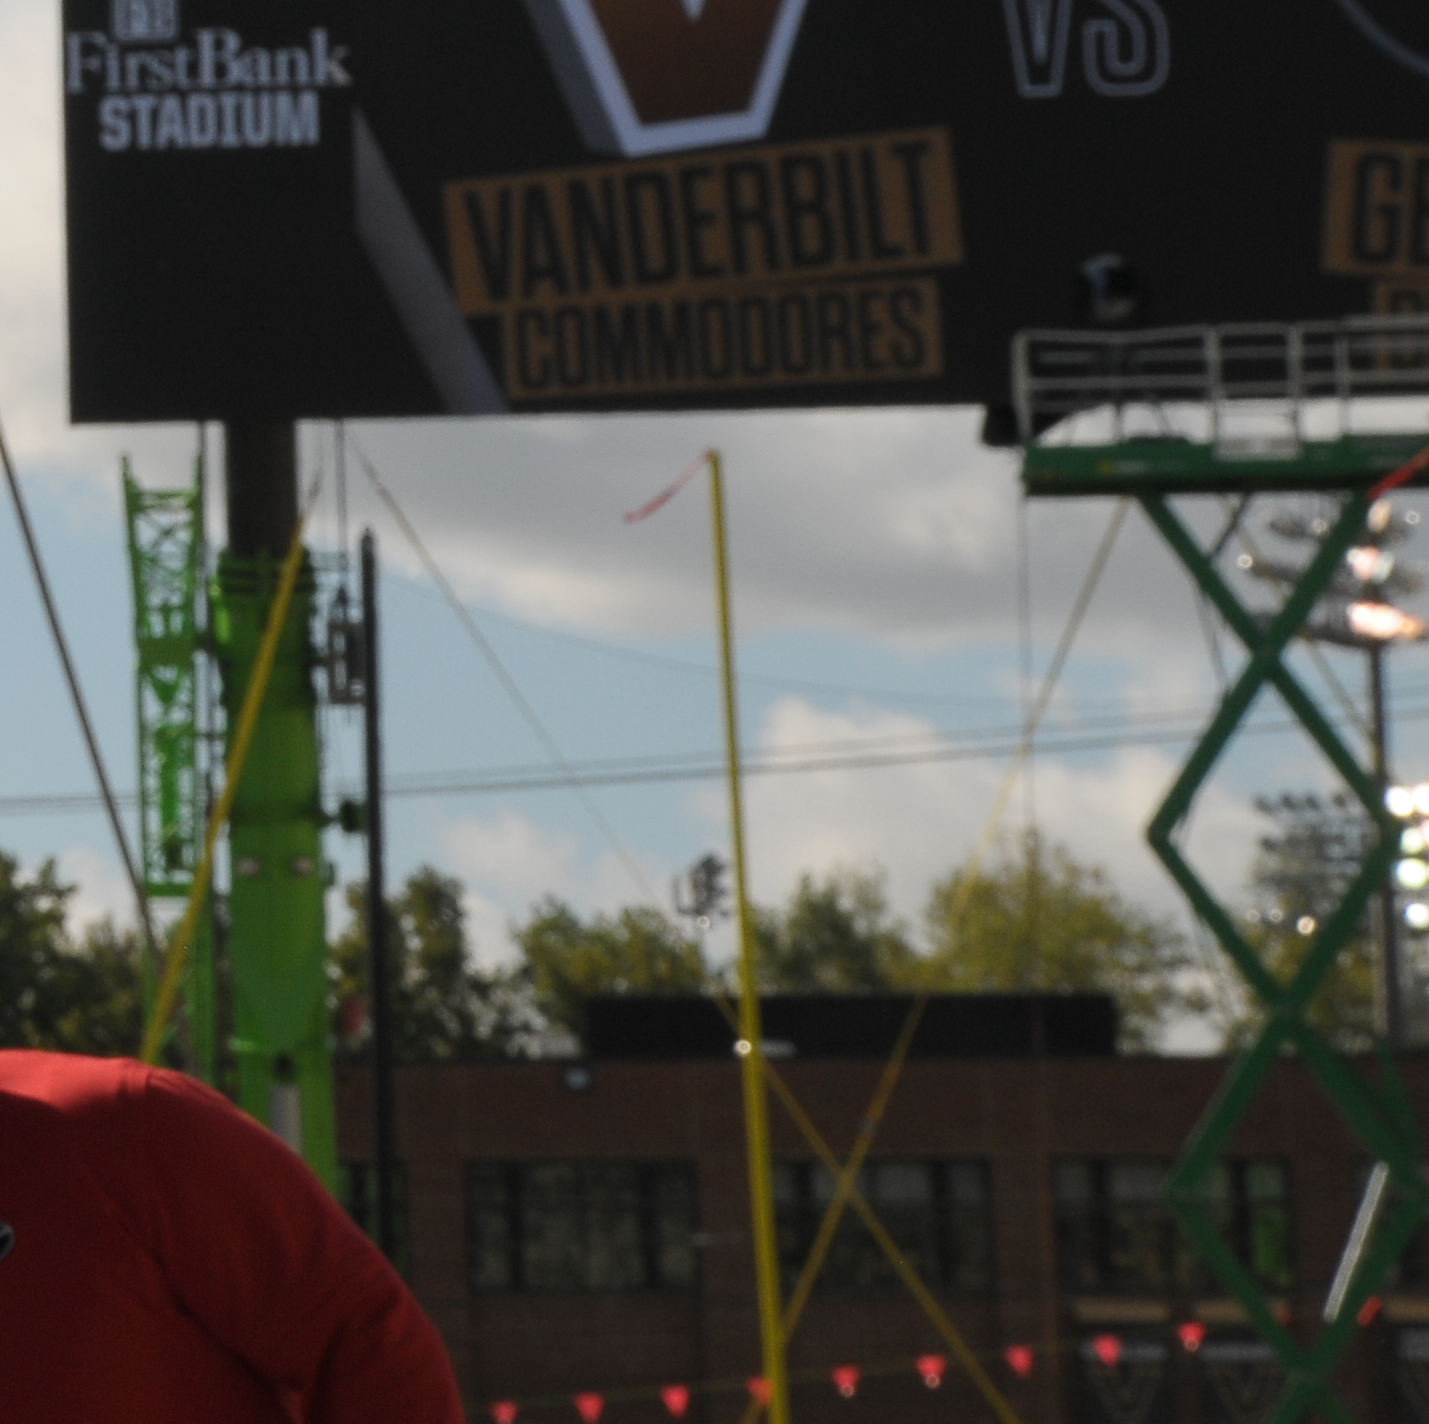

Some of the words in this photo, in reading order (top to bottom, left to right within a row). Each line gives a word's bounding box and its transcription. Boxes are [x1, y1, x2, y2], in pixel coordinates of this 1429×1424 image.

[65, 26, 353, 94] FirstBank
[98, 90, 321, 152] STADIUM
[463, 139, 935, 302] VANDERBILT
[514, 284, 927, 391] COMMODORES
